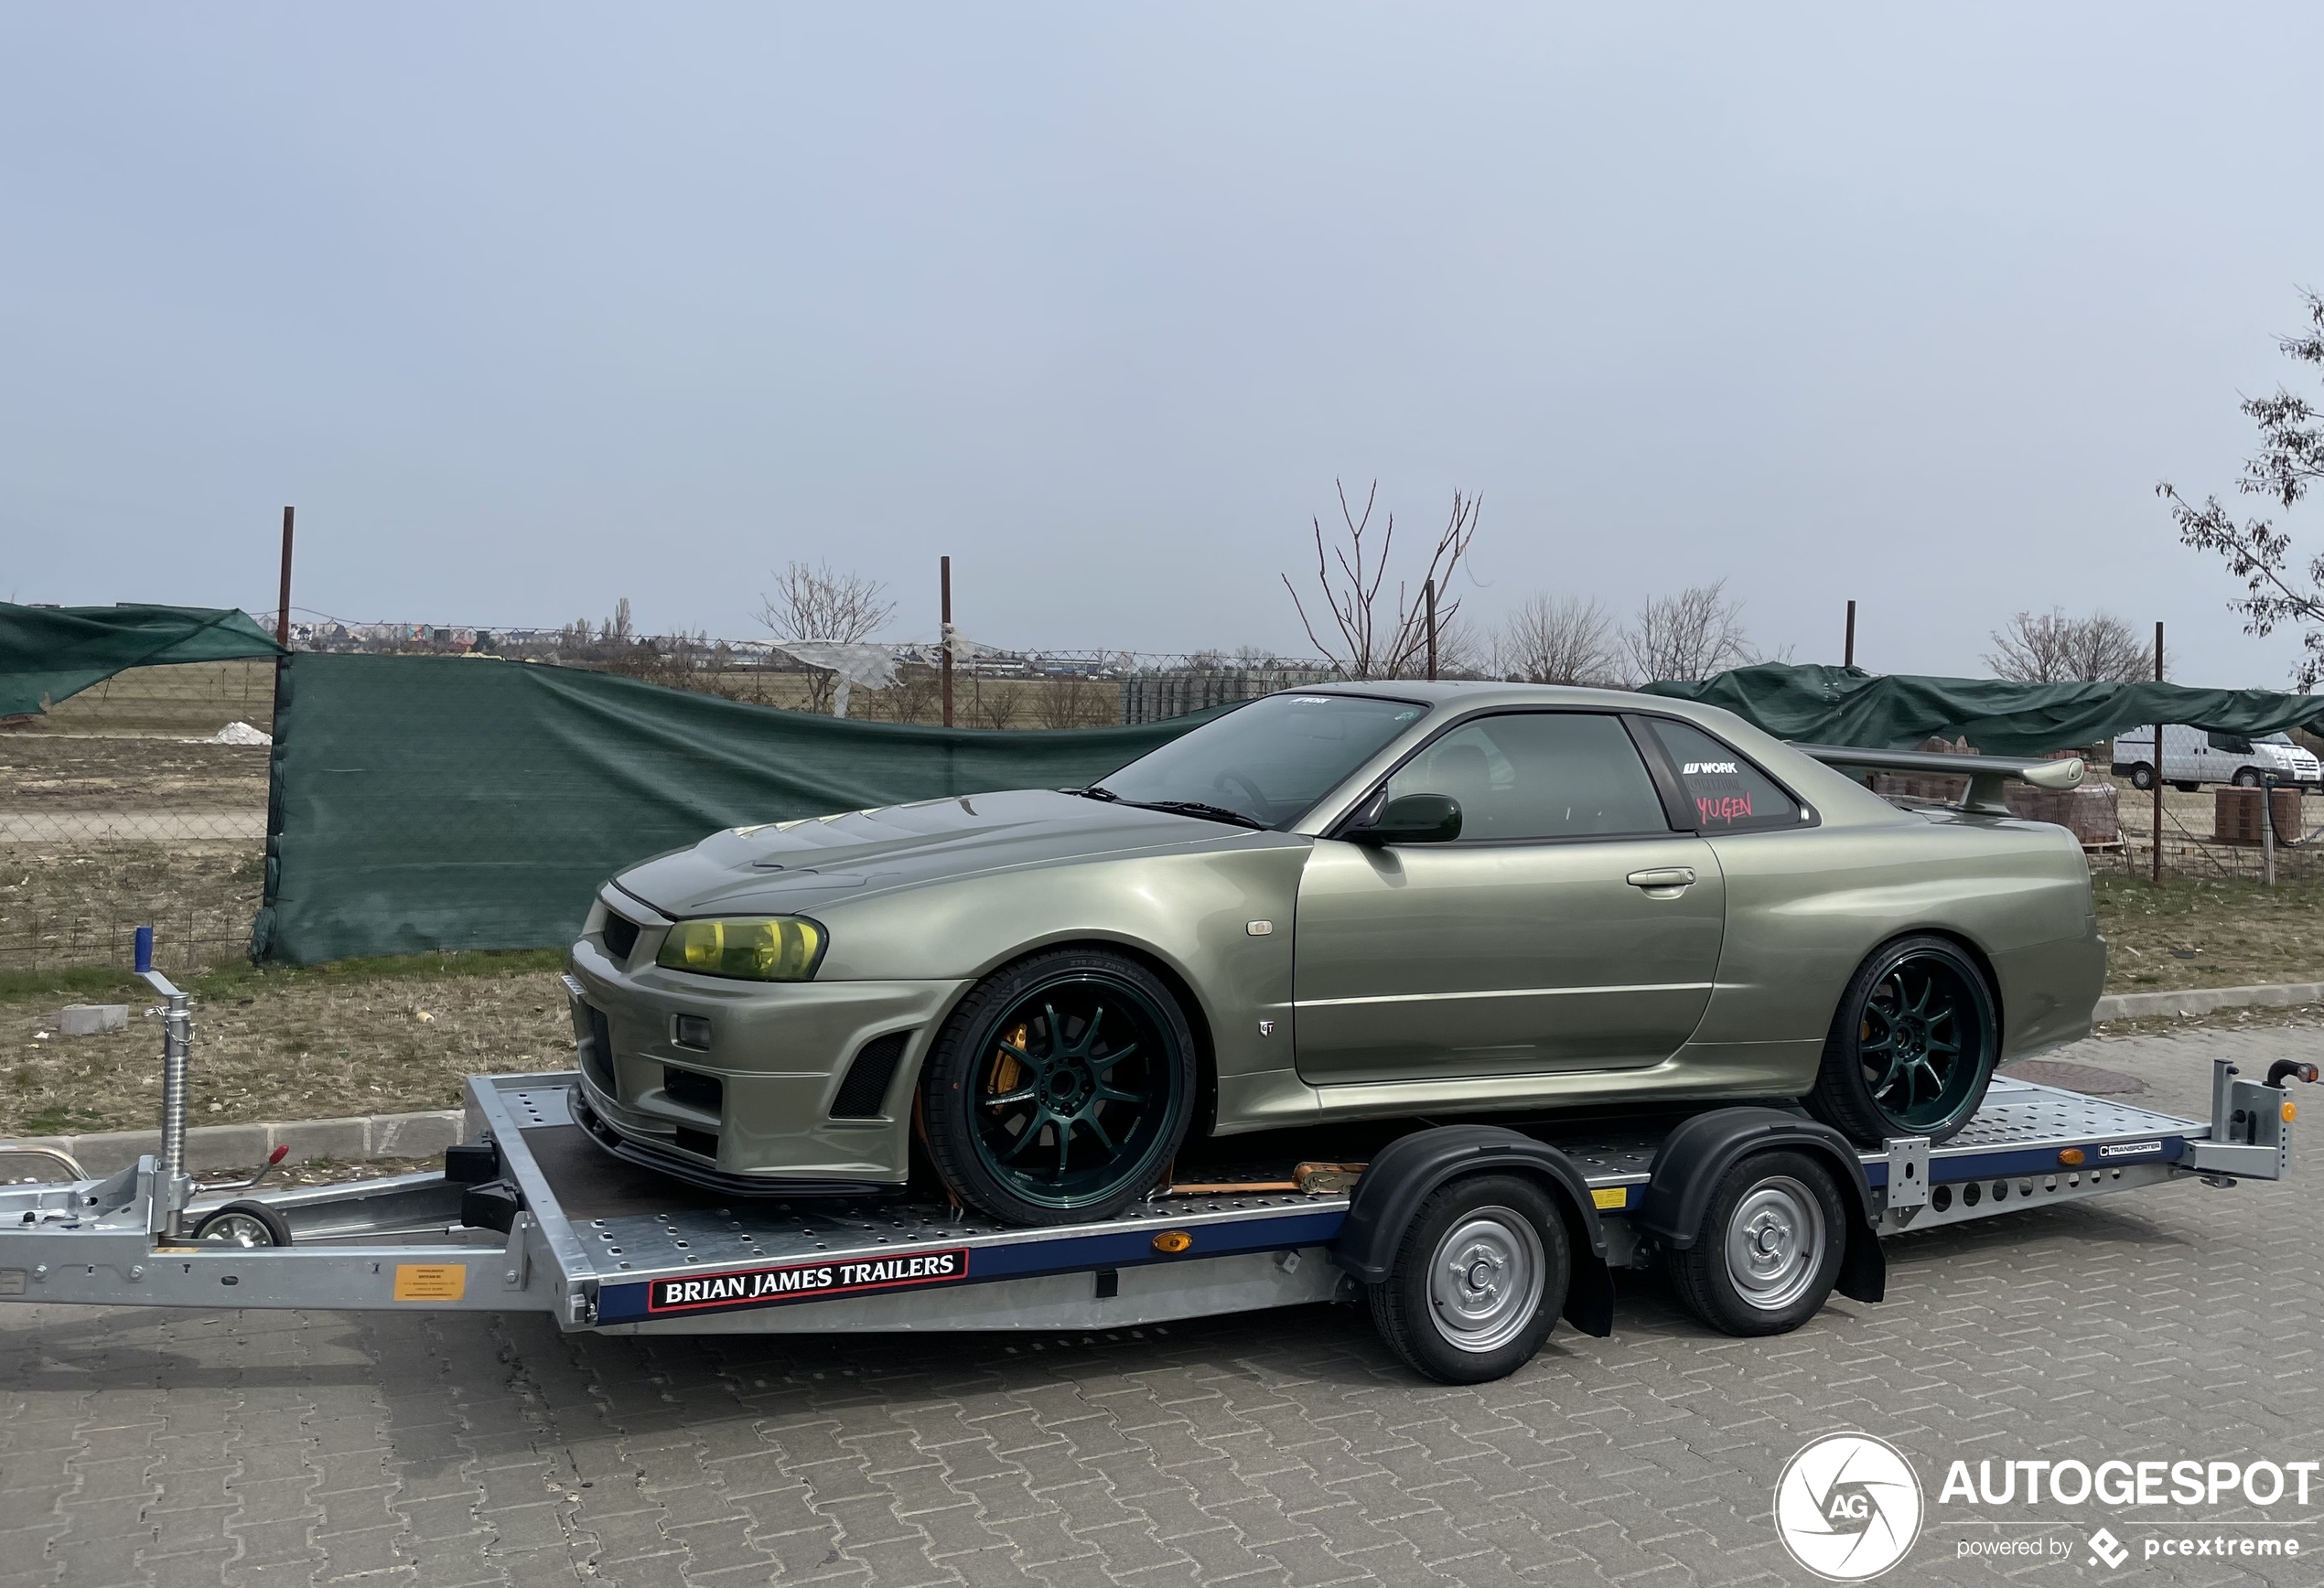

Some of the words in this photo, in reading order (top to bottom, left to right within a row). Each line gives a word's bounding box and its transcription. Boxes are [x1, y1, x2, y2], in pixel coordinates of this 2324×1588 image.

[1700, 762, 1738, 774] WORK
[1695, 790, 1752, 825] YUGEN
[1262, 1024, 1274, 1033] GT
[2110, 1143, 2160, 1153] TRANSPORTER
[1133, 1143, 1176, 1194] KUMHO
[665, 1276, 745, 1304] BRIAN
[748, 1267, 833, 1298] JAMES
[839, 1254, 954, 1285] TRAILERS
